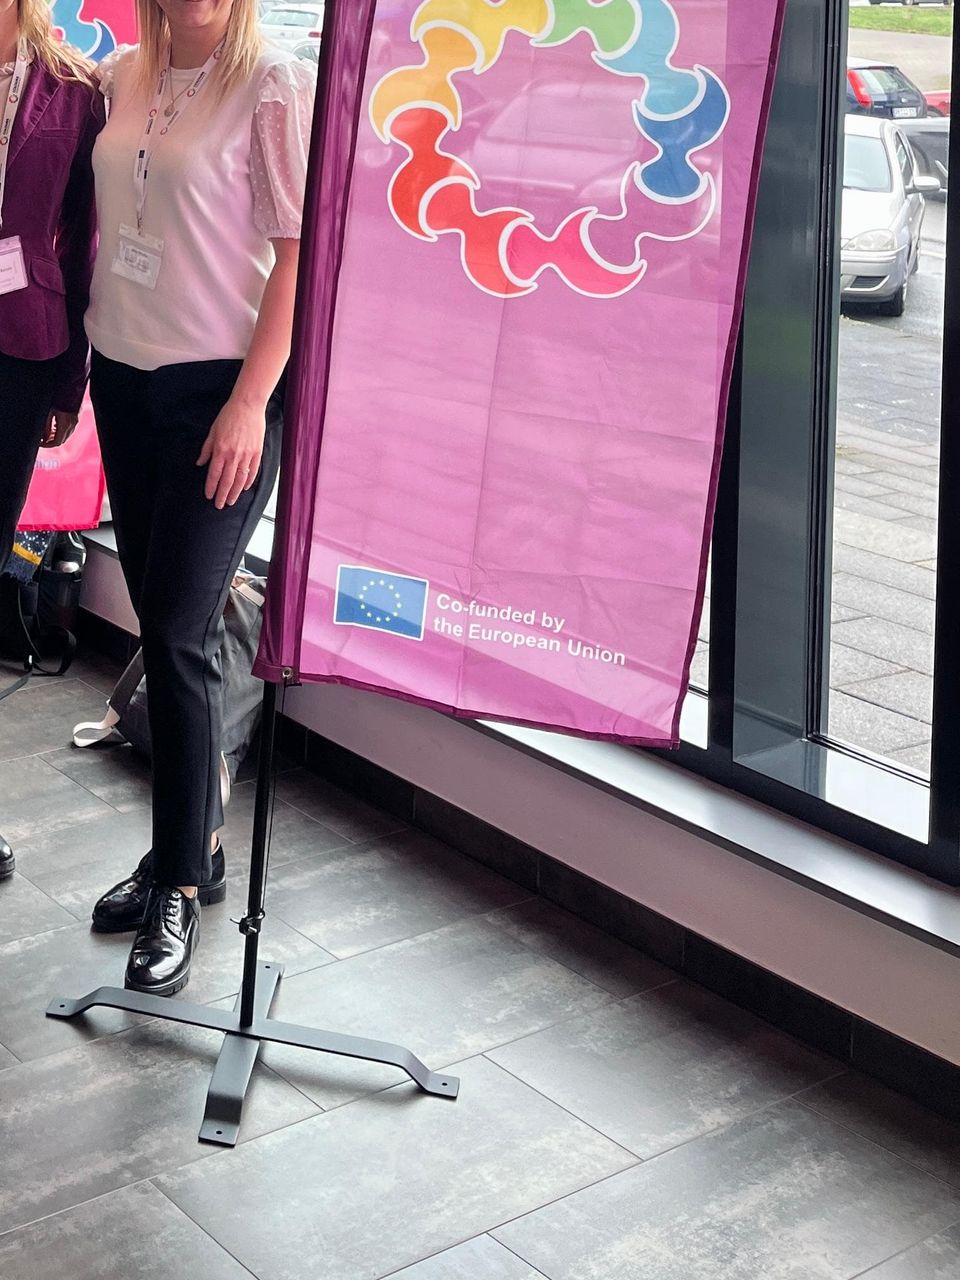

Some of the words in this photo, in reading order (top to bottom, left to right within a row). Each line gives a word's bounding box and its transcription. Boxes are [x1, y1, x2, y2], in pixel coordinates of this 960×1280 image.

[436, 594, 535, 625] Co-funded
[542, 612, 565, 632] by
[433, 617, 463, 637] the
[469, 624, 561, 652] European
[568, 639, 626, 665] Union
